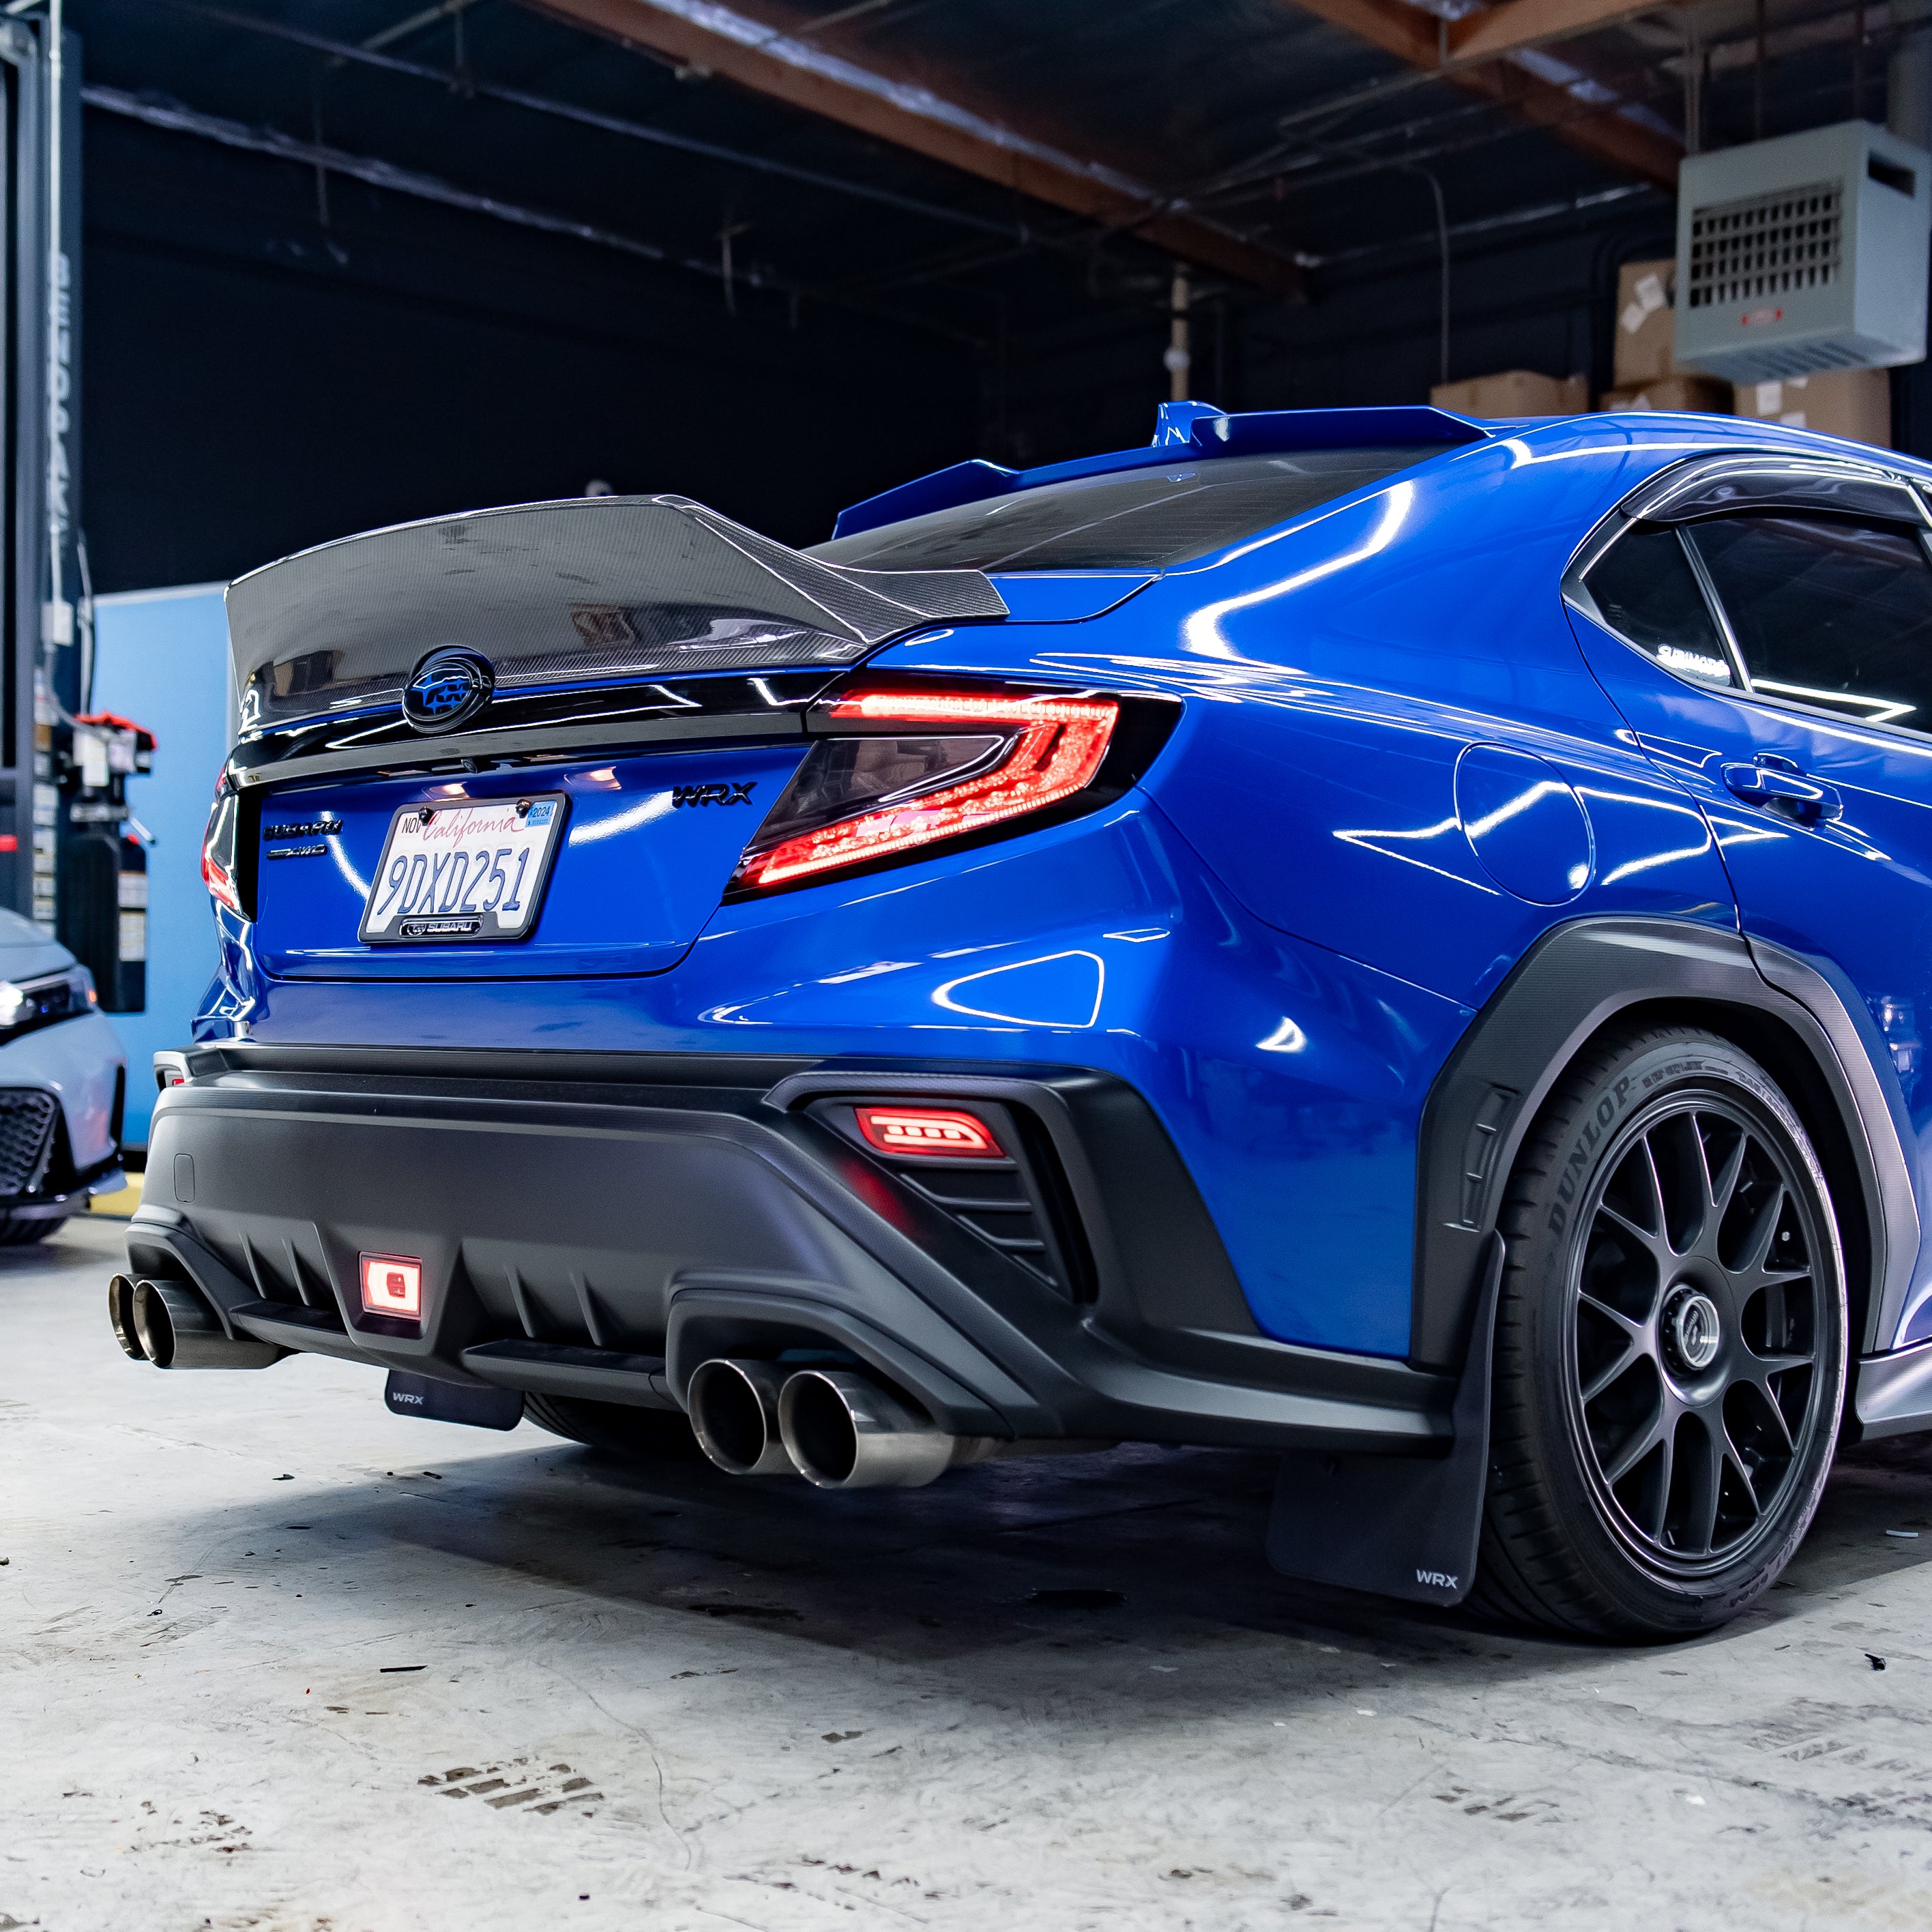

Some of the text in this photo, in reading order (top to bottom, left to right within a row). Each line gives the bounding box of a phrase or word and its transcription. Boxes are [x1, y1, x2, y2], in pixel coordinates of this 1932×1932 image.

[672, 781, 758, 808] WRX
[263, 819, 343, 841] SUBARU
[401, 817, 422, 834] NOV
[423, 807, 524, 849] California
[377, 847, 530, 916] 9DXD251
[426, 922, 473, 933] SUBARU
[1548, 1076, 1630, 1239] DUNLOP
[392, 1391, 424, 1405] WRX
[1416, 1568, 1459, 1590] WRX
